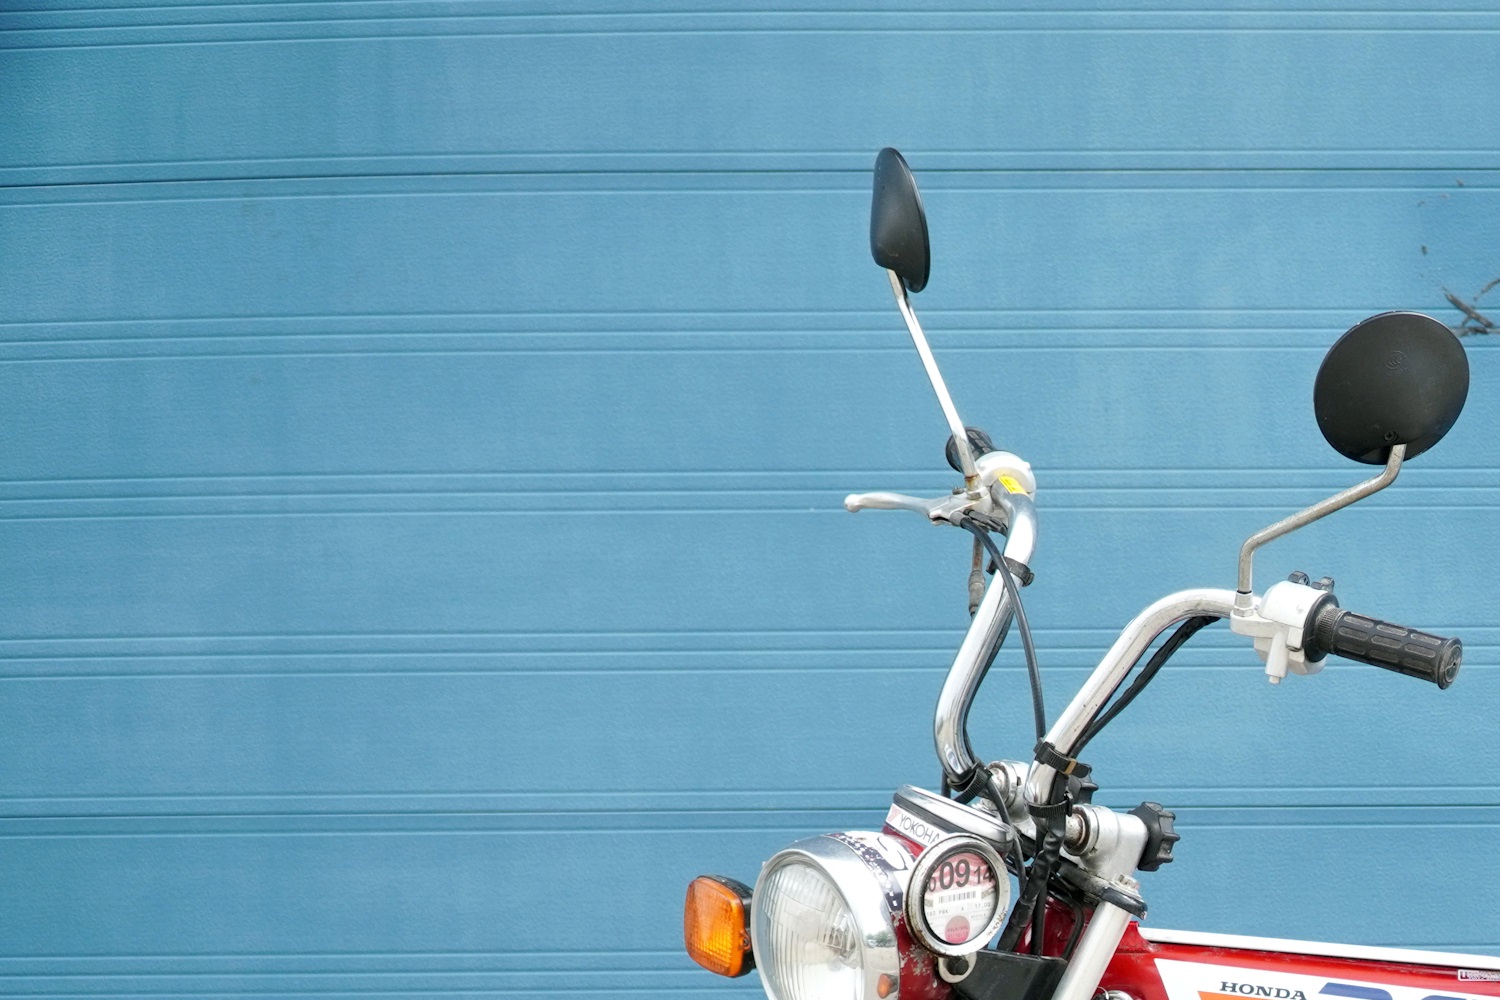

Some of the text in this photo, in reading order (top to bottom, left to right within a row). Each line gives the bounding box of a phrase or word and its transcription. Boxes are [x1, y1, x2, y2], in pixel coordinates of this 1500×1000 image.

[900, 813, 940, 844] YOKOHA
[939, 858, 971, 890] 09
[973, 865, 994, 885] 14
